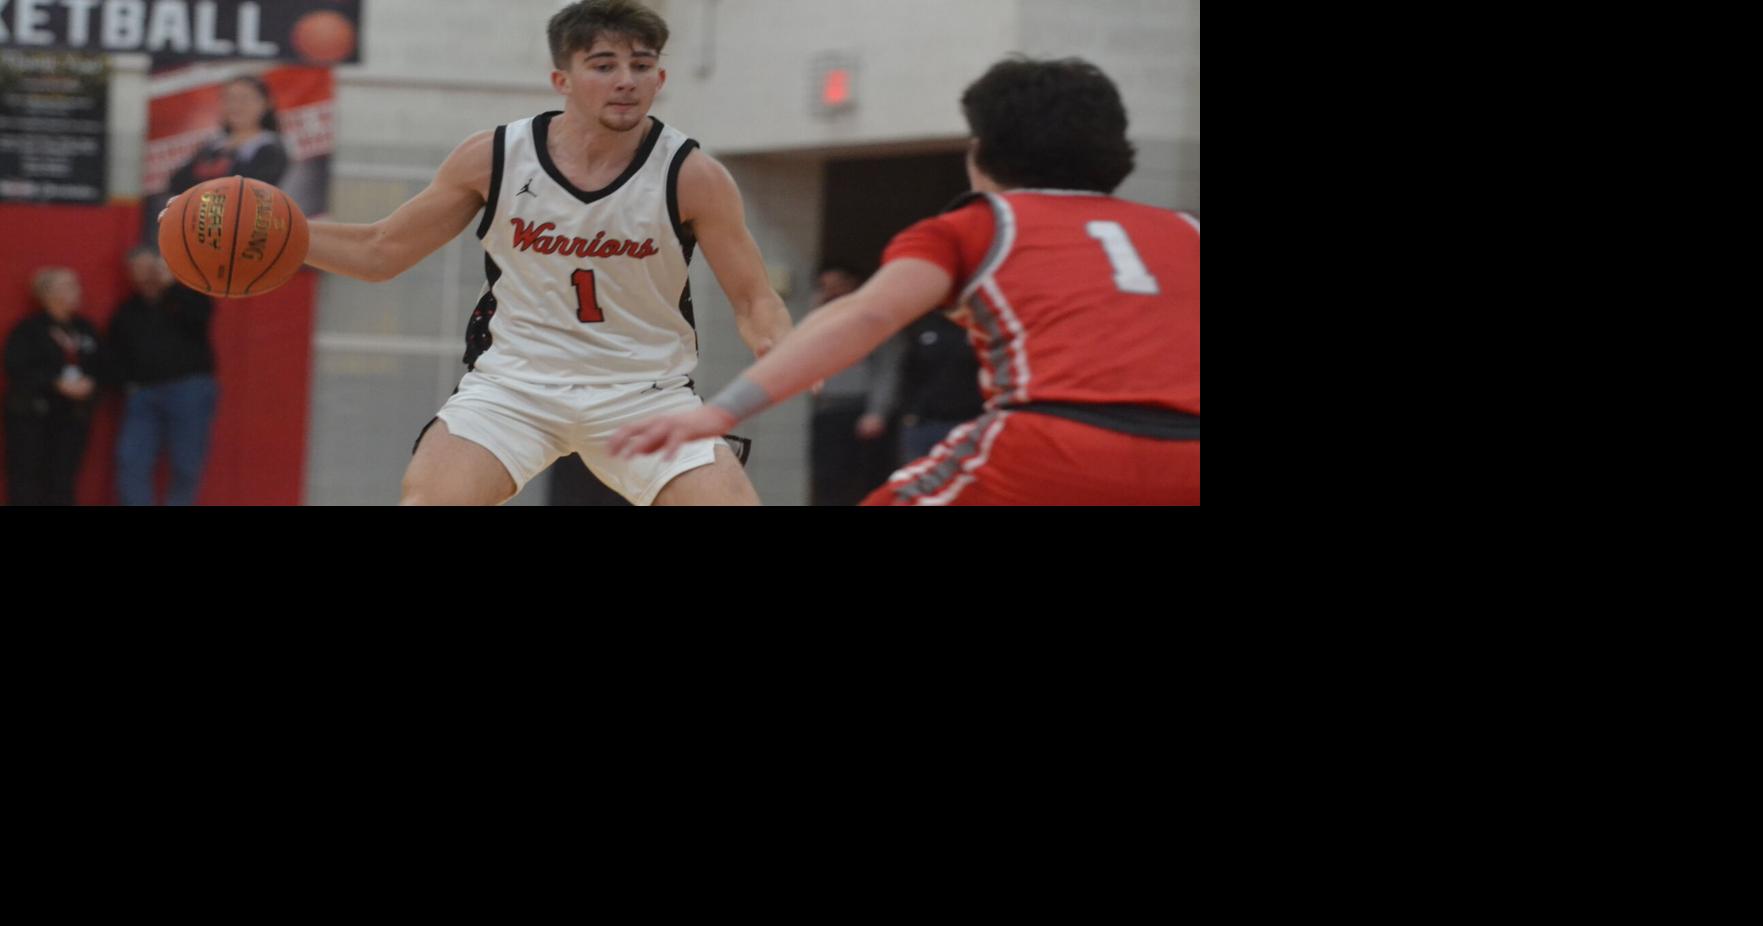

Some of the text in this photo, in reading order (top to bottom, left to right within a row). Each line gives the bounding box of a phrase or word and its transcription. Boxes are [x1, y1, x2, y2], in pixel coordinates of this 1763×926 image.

[510, 217, 659, 259] Warriors
[1085, 219, 1162, 295] 1
[571, 268, 605, 323] 1
